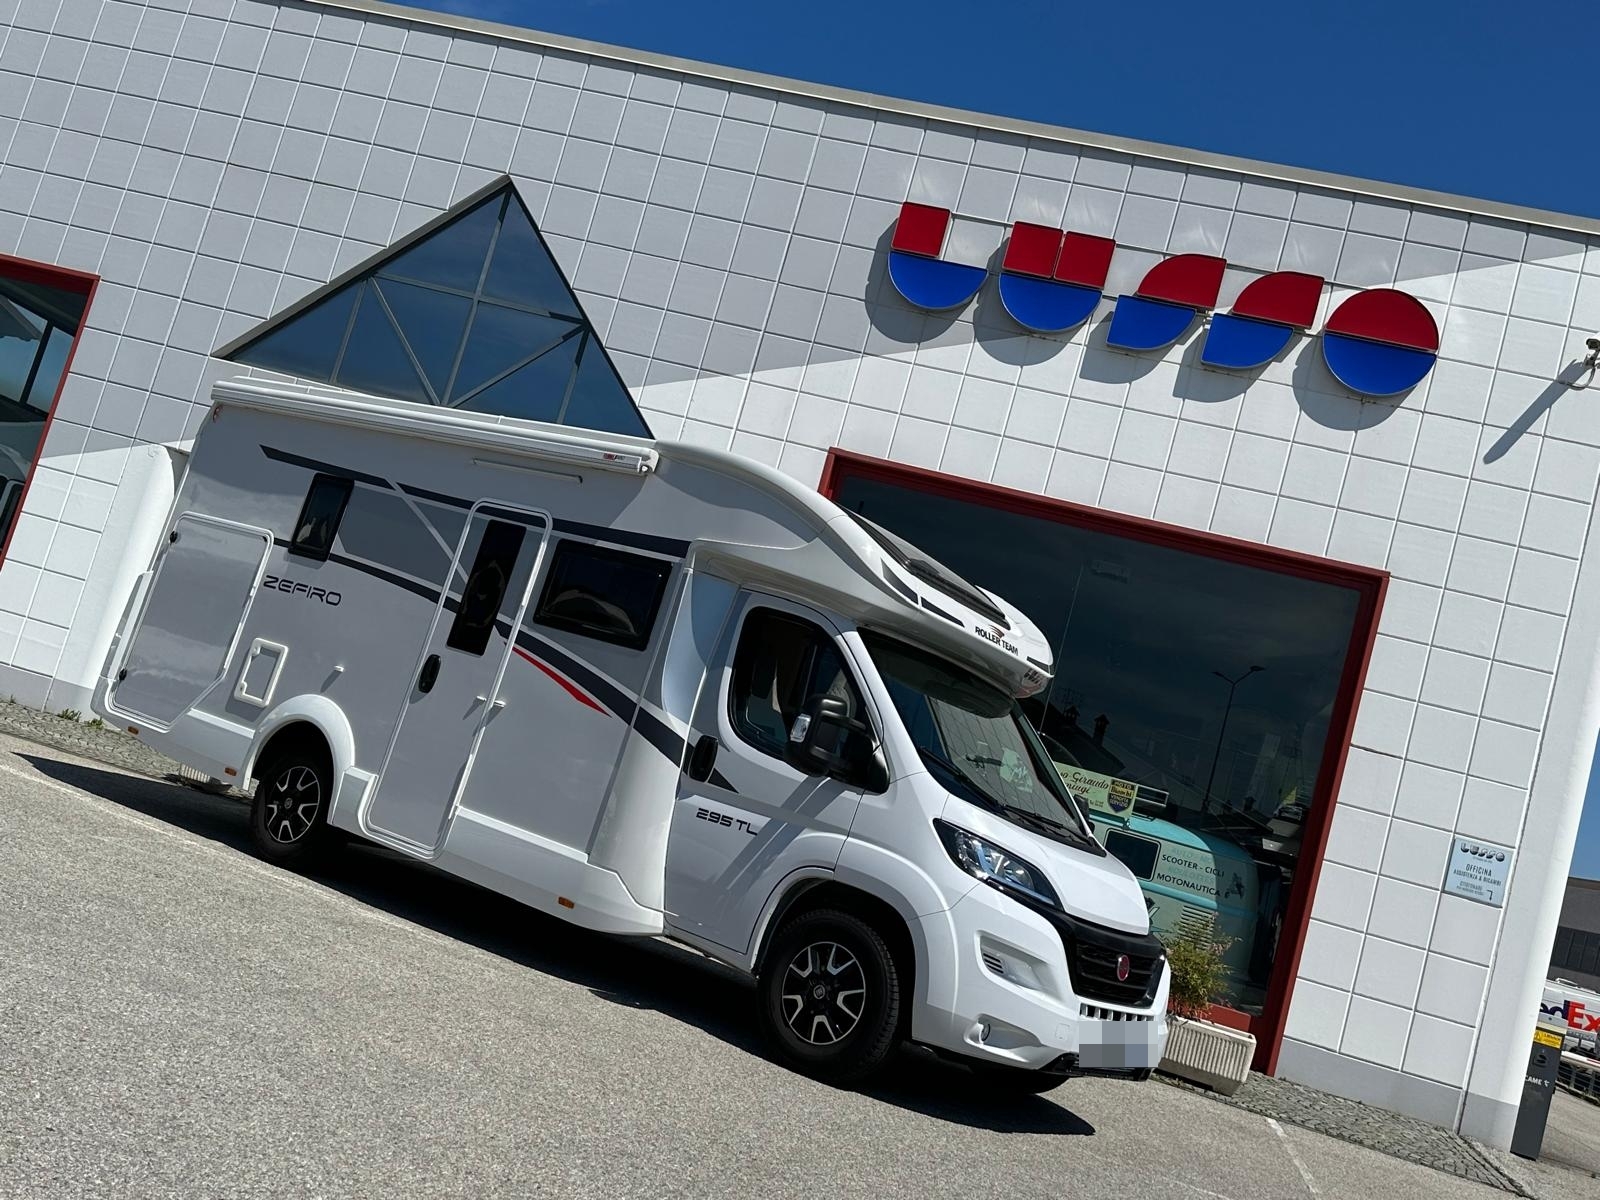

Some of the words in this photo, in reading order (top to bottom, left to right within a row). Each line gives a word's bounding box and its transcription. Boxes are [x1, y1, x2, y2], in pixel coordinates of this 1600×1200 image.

[263, 575, 342, 606] ZEFIRO
[975, 626, 1001, 646] ROLLER
[1002, 640, 1019, 656] TEAM
[696, 807, 733, 828] 295
[736, 819, 758, 836] TL
[1460, 843, 1506, 862] LUSSO
[1162, 854, 1198, 870] SCOOTER
[1205, 866, 1225, 878] CICLI
[1453, 869, 1478, 880] ASSISTENZA
[1483, 877, 1502, 887] RICAMBI
[1466, 864, 1492, 877] OFFICINA
[1157, 873, 1221, 897] MOTONAUTICA
